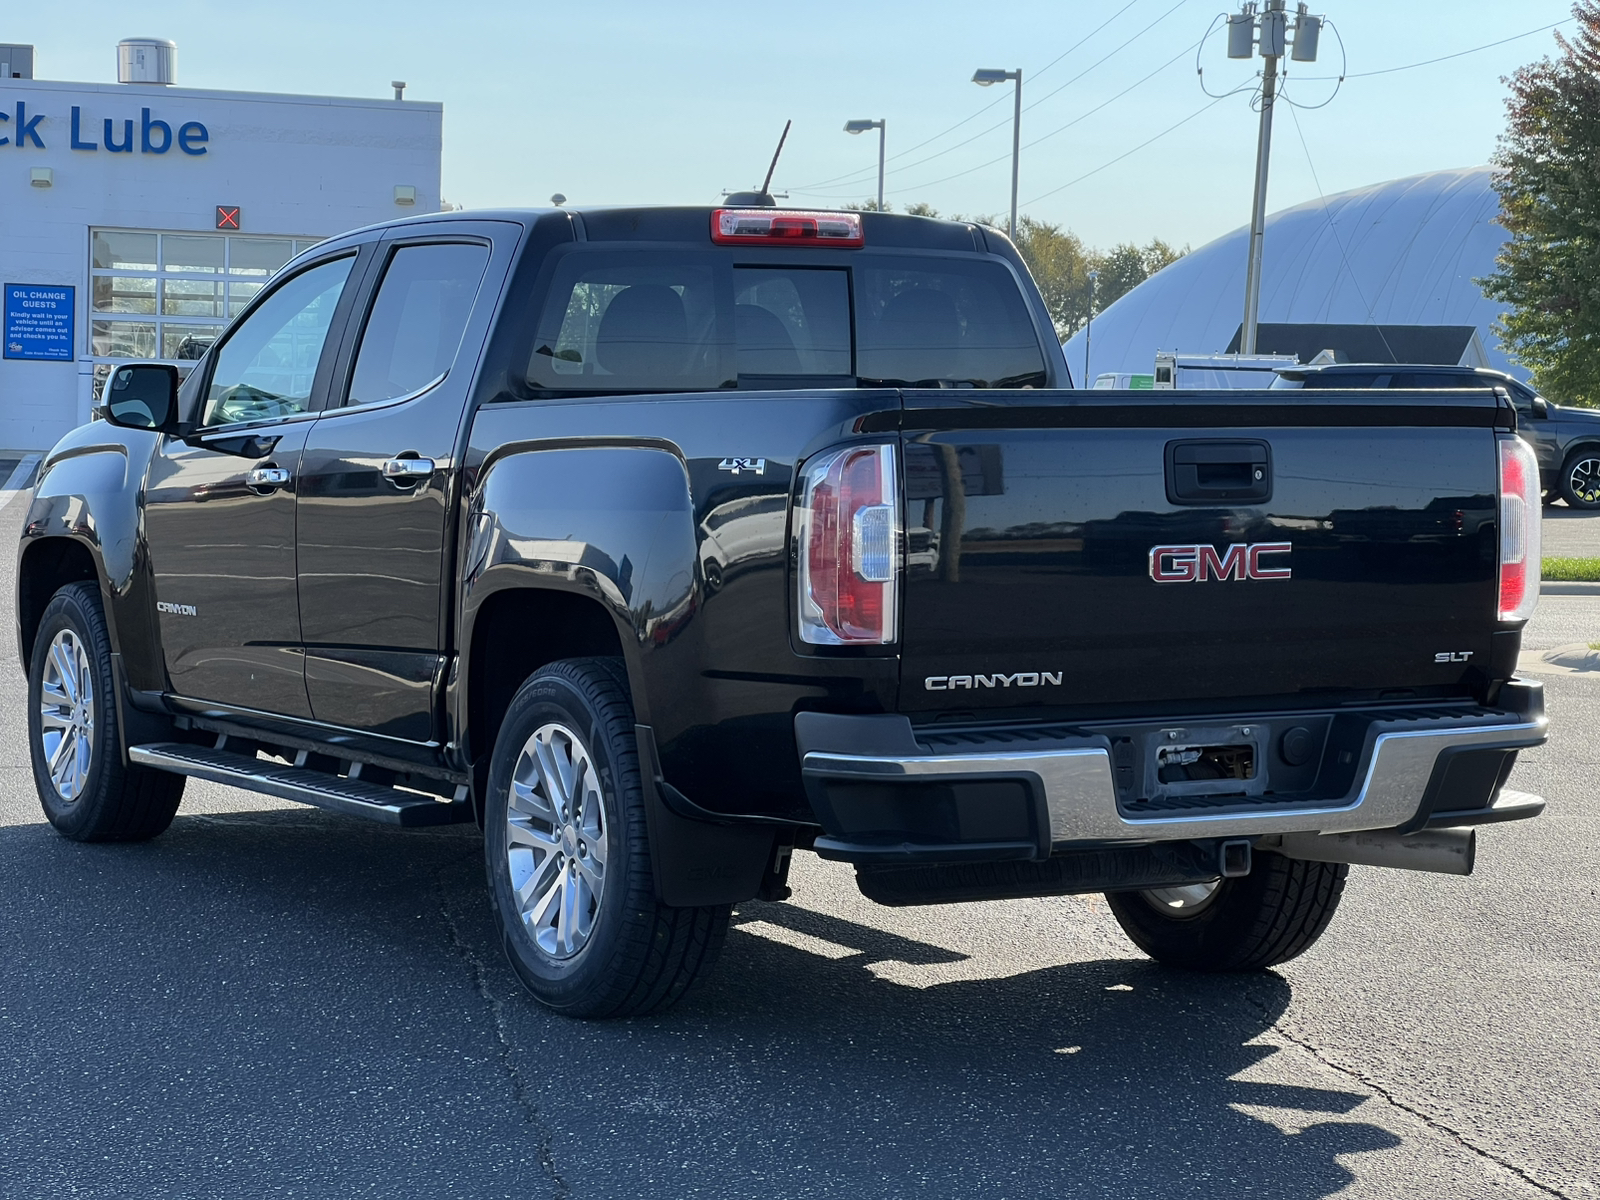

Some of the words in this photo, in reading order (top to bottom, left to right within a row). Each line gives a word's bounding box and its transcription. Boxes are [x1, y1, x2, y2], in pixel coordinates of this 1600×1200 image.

[71, 106, 209, 155] Lube
[30, 292, 66, 300] CHANGE
[22, 300, 56, 308] GUESTS
[1149, 542, 1292, 582] GMC
[157, 601, 197, 616] CANYON
[1434, 652, 1474, 662] SLT
[925, 672, 1063, 690] CANYON
